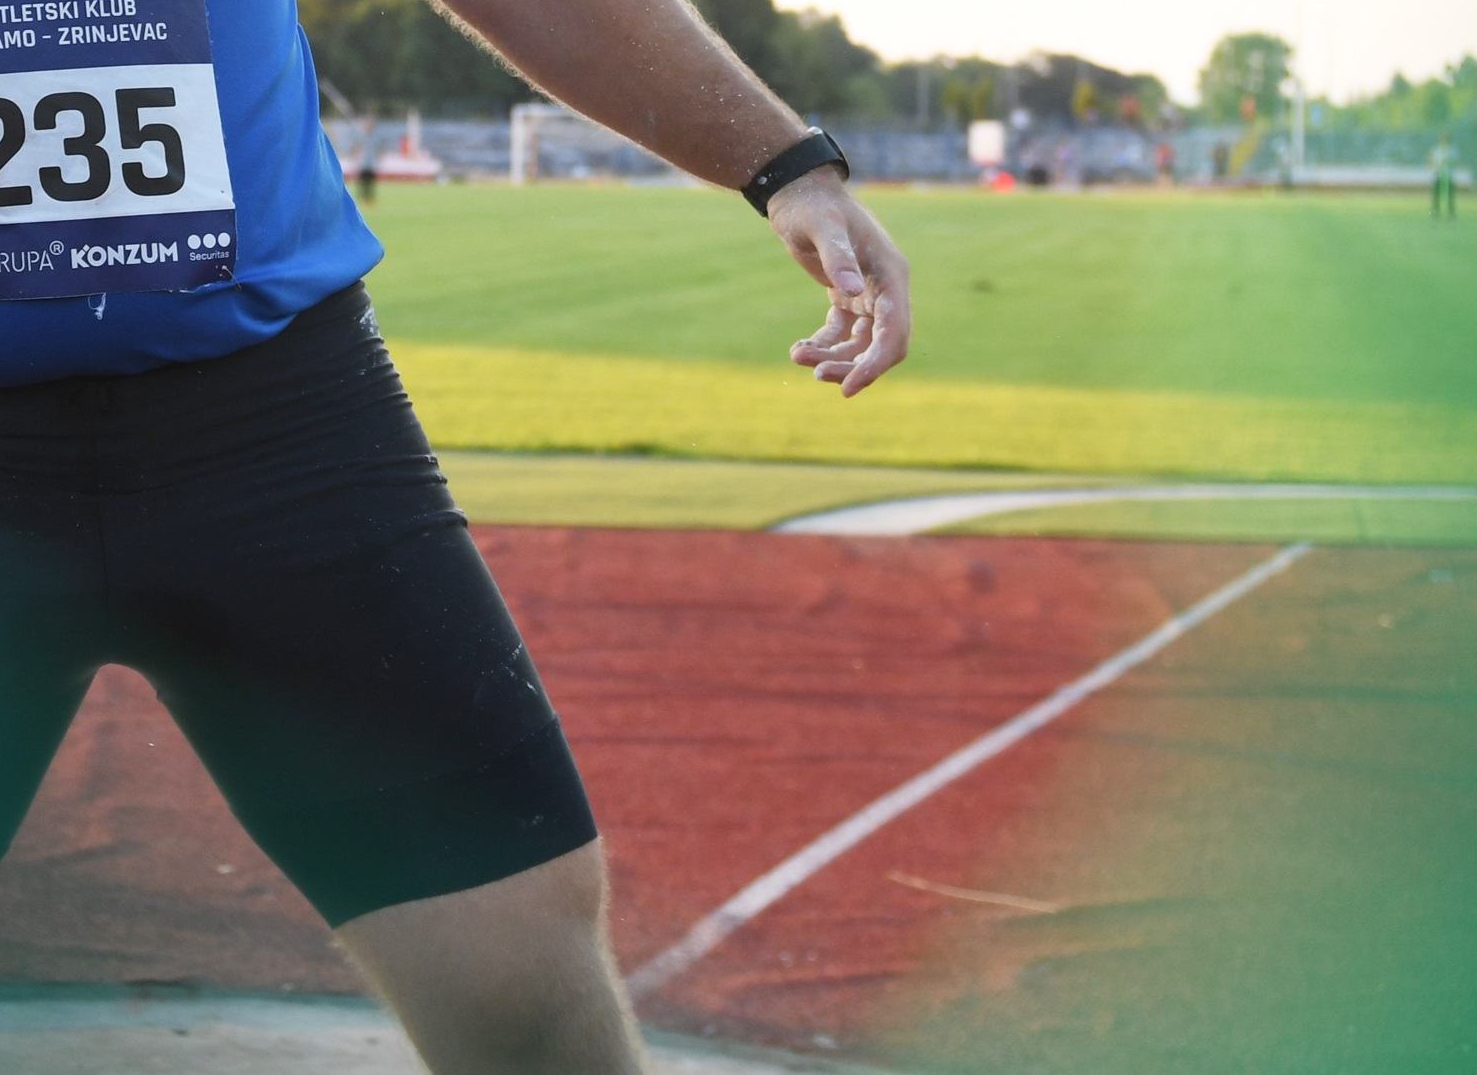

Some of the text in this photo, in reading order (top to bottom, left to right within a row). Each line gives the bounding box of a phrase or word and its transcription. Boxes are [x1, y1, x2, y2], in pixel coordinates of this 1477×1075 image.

[58, 22, 168, 46] ZRINJEVAC
[71, 241, 179, 269] KONZUM
[189, 250, 230, 262] Securitas
